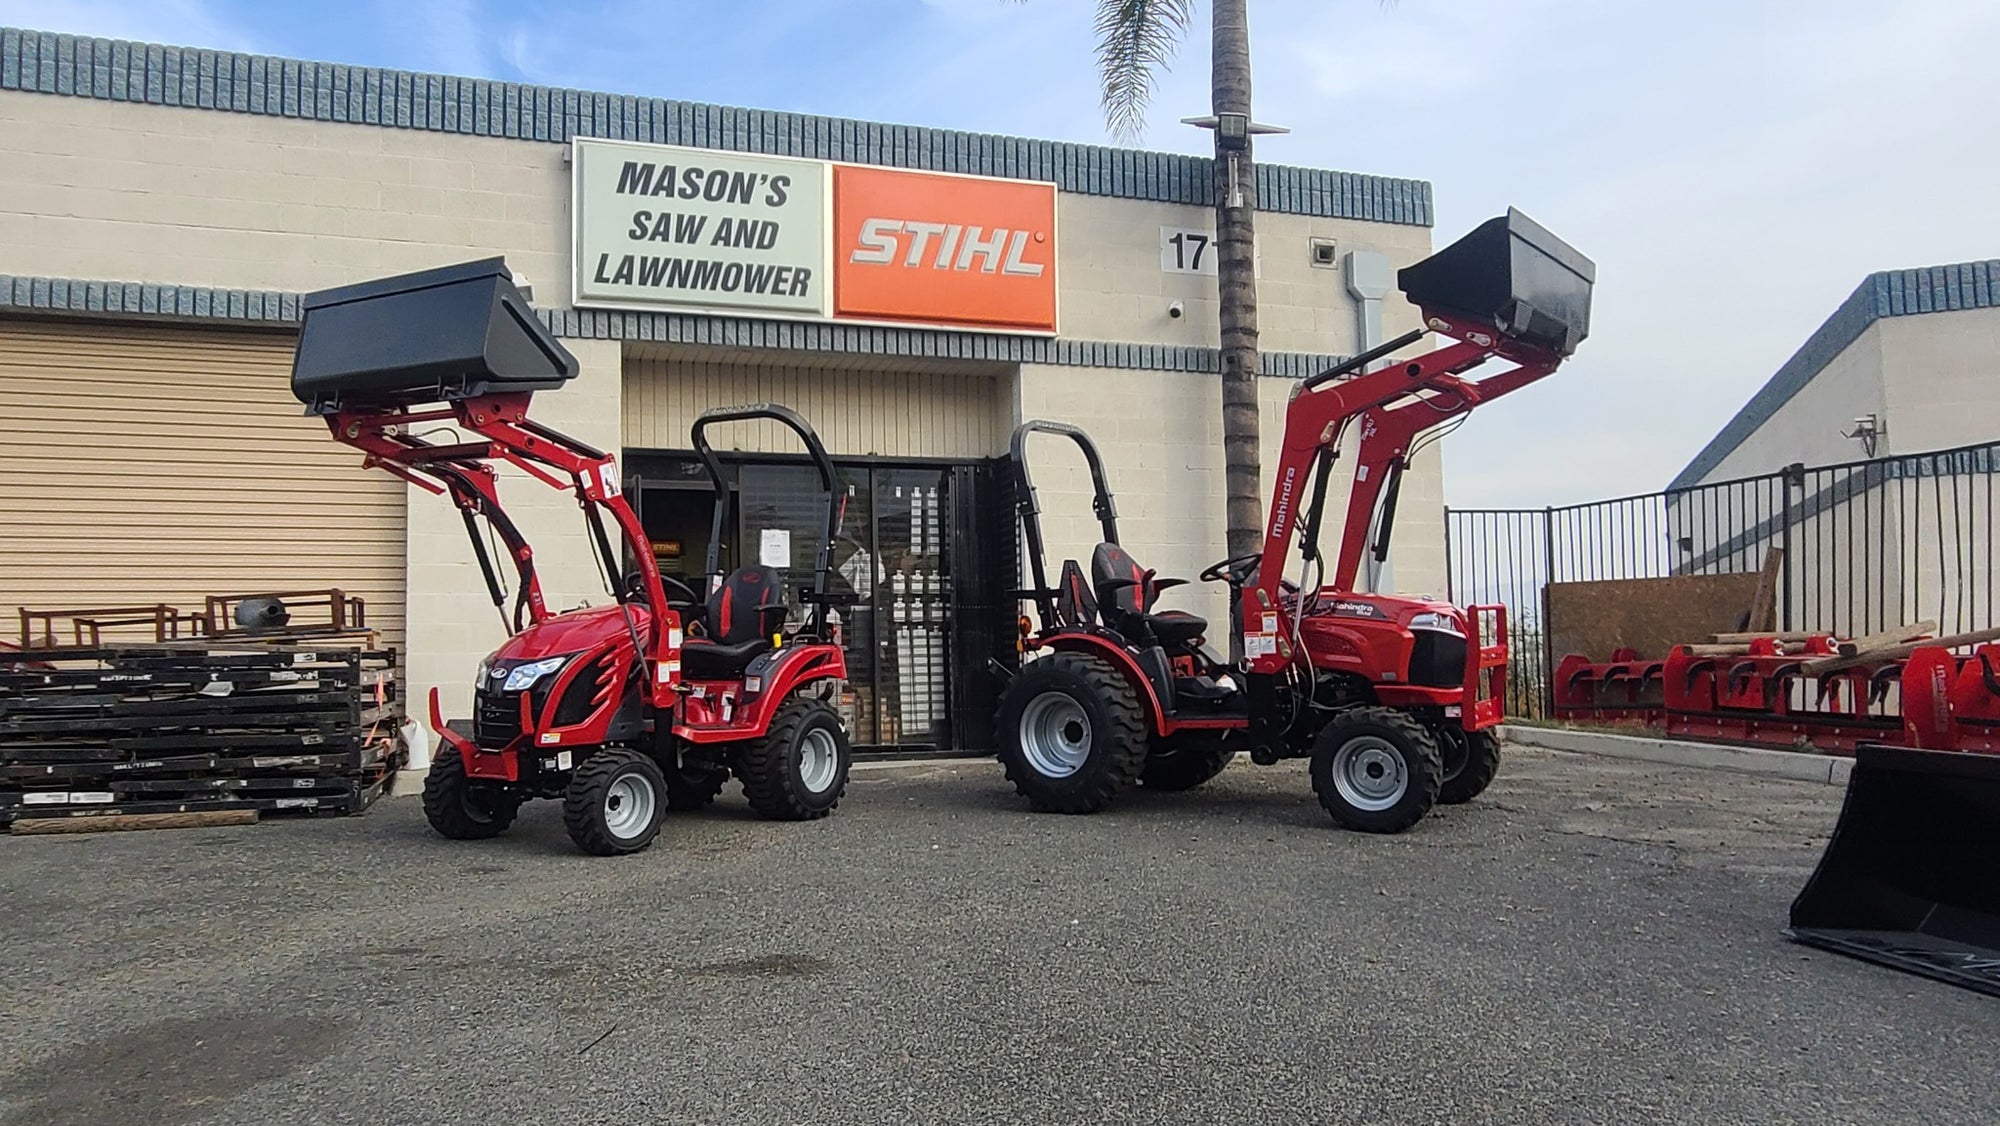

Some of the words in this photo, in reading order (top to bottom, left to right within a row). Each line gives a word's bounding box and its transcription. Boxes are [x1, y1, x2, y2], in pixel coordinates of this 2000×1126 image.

[616, 161, 791, 207] MASON'S
[628, 210, 708, 244] SAW
[710, 217, 780, 250] AND
[850, 218, 1044, 277] STIHL
[1168, 233, 1217, 270] 17
[594, 253, 812, 297] LAWNMOWER
